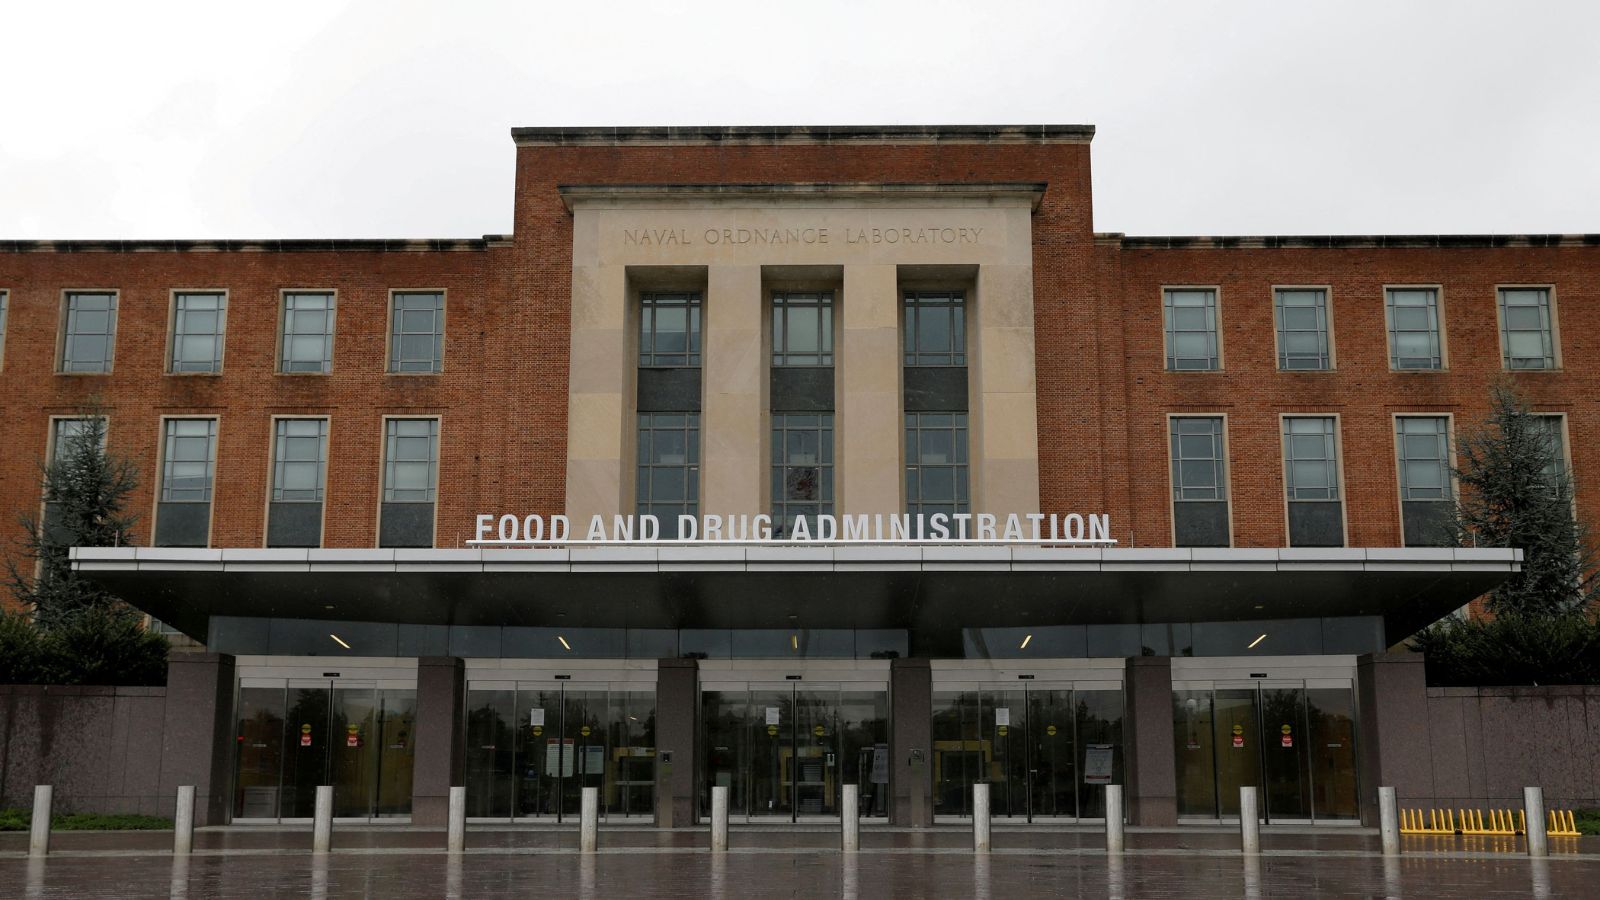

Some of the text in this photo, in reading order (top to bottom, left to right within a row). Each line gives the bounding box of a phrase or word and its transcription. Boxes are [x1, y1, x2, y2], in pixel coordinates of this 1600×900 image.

[624, 228, 984, 245] NAVAL ORDNANCE LABORATORY
[475, 513, 1110, 540] FOOD AND DRUG ADMINISTRATION
